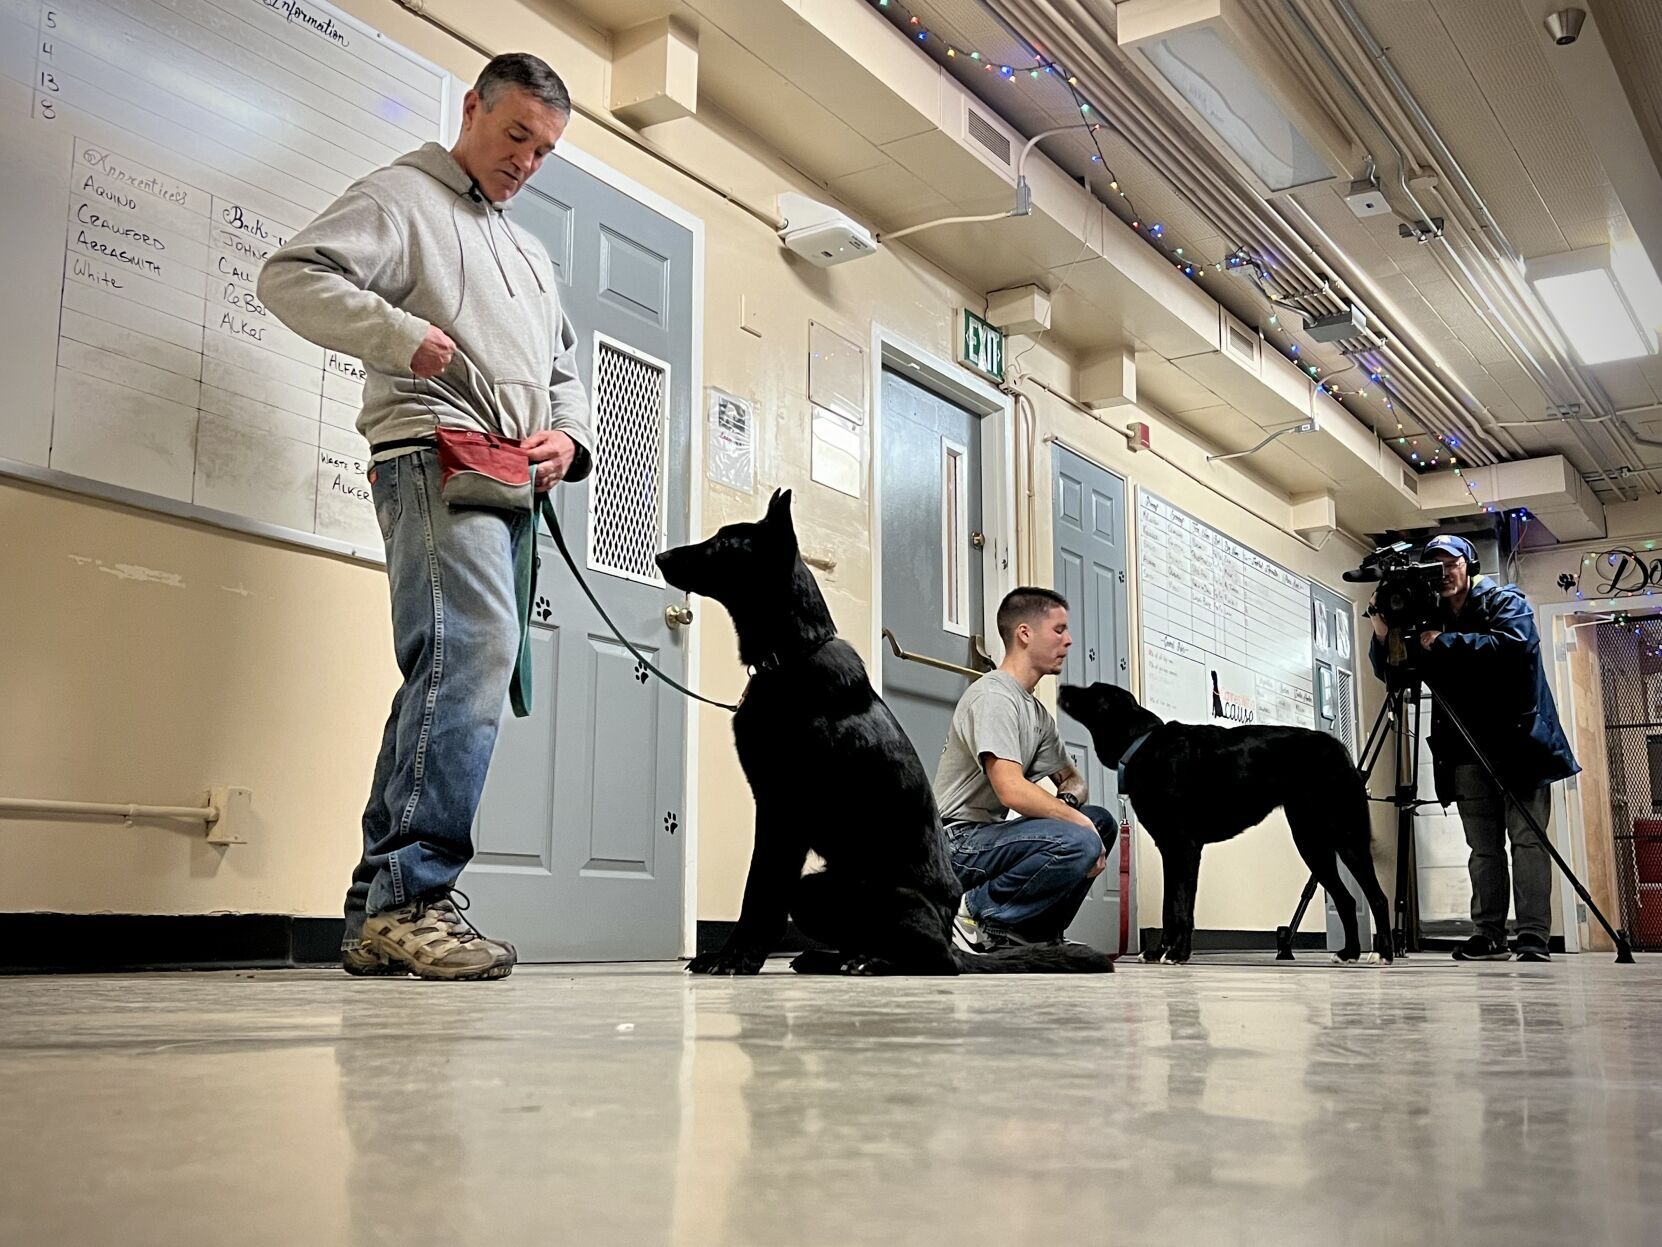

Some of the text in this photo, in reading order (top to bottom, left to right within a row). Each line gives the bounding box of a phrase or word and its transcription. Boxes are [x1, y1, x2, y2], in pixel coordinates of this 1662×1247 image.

[46, 11, 57, 29] 5
[42, 42, 54, 61] 4
[41, 71, 60, 92] 13
[40, 99, 56, 120] 8
[83, 174, 137, 210] AQUINO
[77, 203, 166, 250] CRAWFORD
[73, 258, 124, 289] White
[968, 315, 1000, 375] EXIT
[331, 473, 374, 504] ALKER
